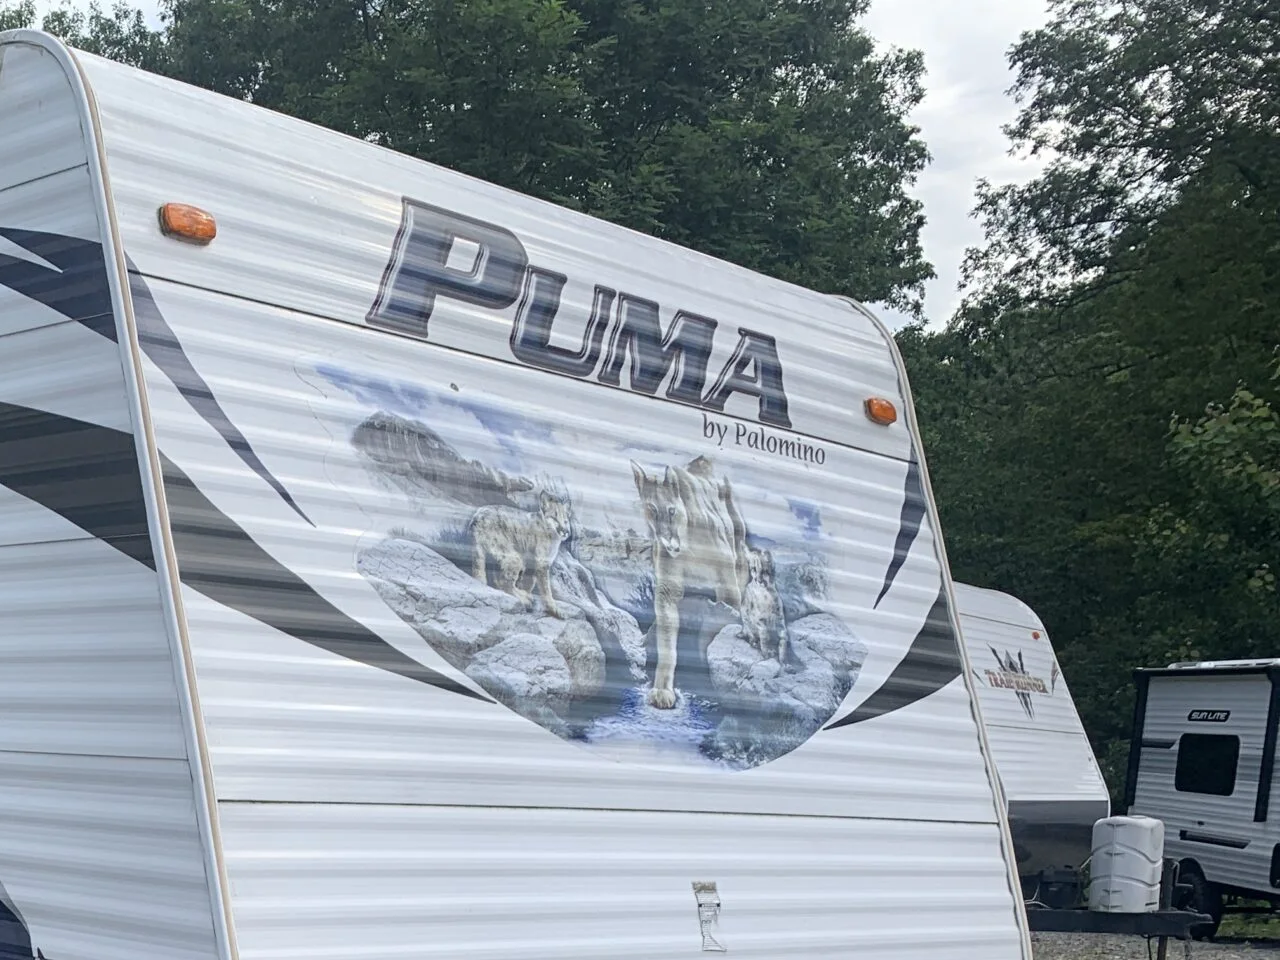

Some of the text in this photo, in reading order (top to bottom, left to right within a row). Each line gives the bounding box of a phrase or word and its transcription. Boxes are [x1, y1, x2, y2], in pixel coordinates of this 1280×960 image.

[365, 196, 792, 428] PUMA
[702, 413, 825, 465] by Palomino
